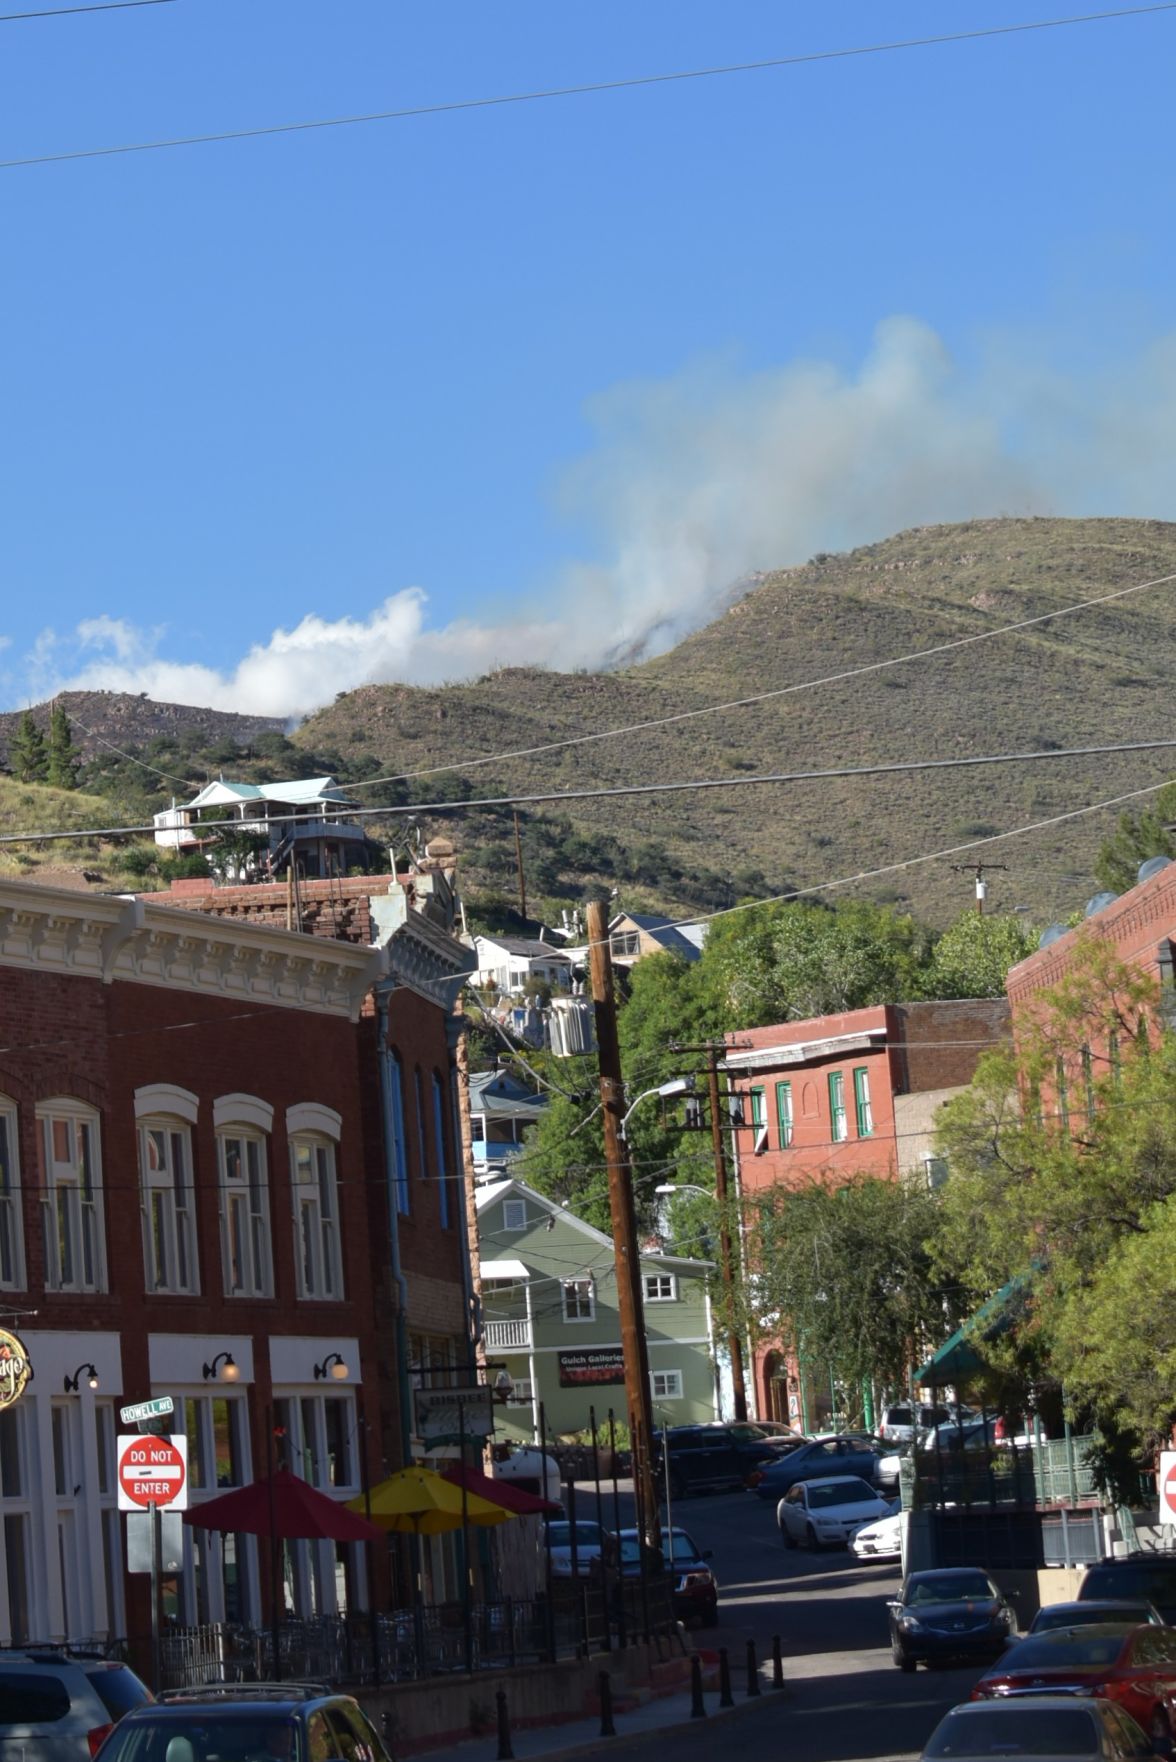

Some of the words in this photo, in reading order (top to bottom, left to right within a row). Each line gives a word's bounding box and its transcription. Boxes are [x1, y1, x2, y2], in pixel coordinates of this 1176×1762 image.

[561, 1356, 586, 1365] Gulch
[123, 1402, 158, 1420] HOWELL
[159, 1400, 172, 1411] AVE
[130, 1450, 146, 1463] DO
[150, 1450, 173, 1463] NOT
[133, 1482, 170, 1495] ENTER
